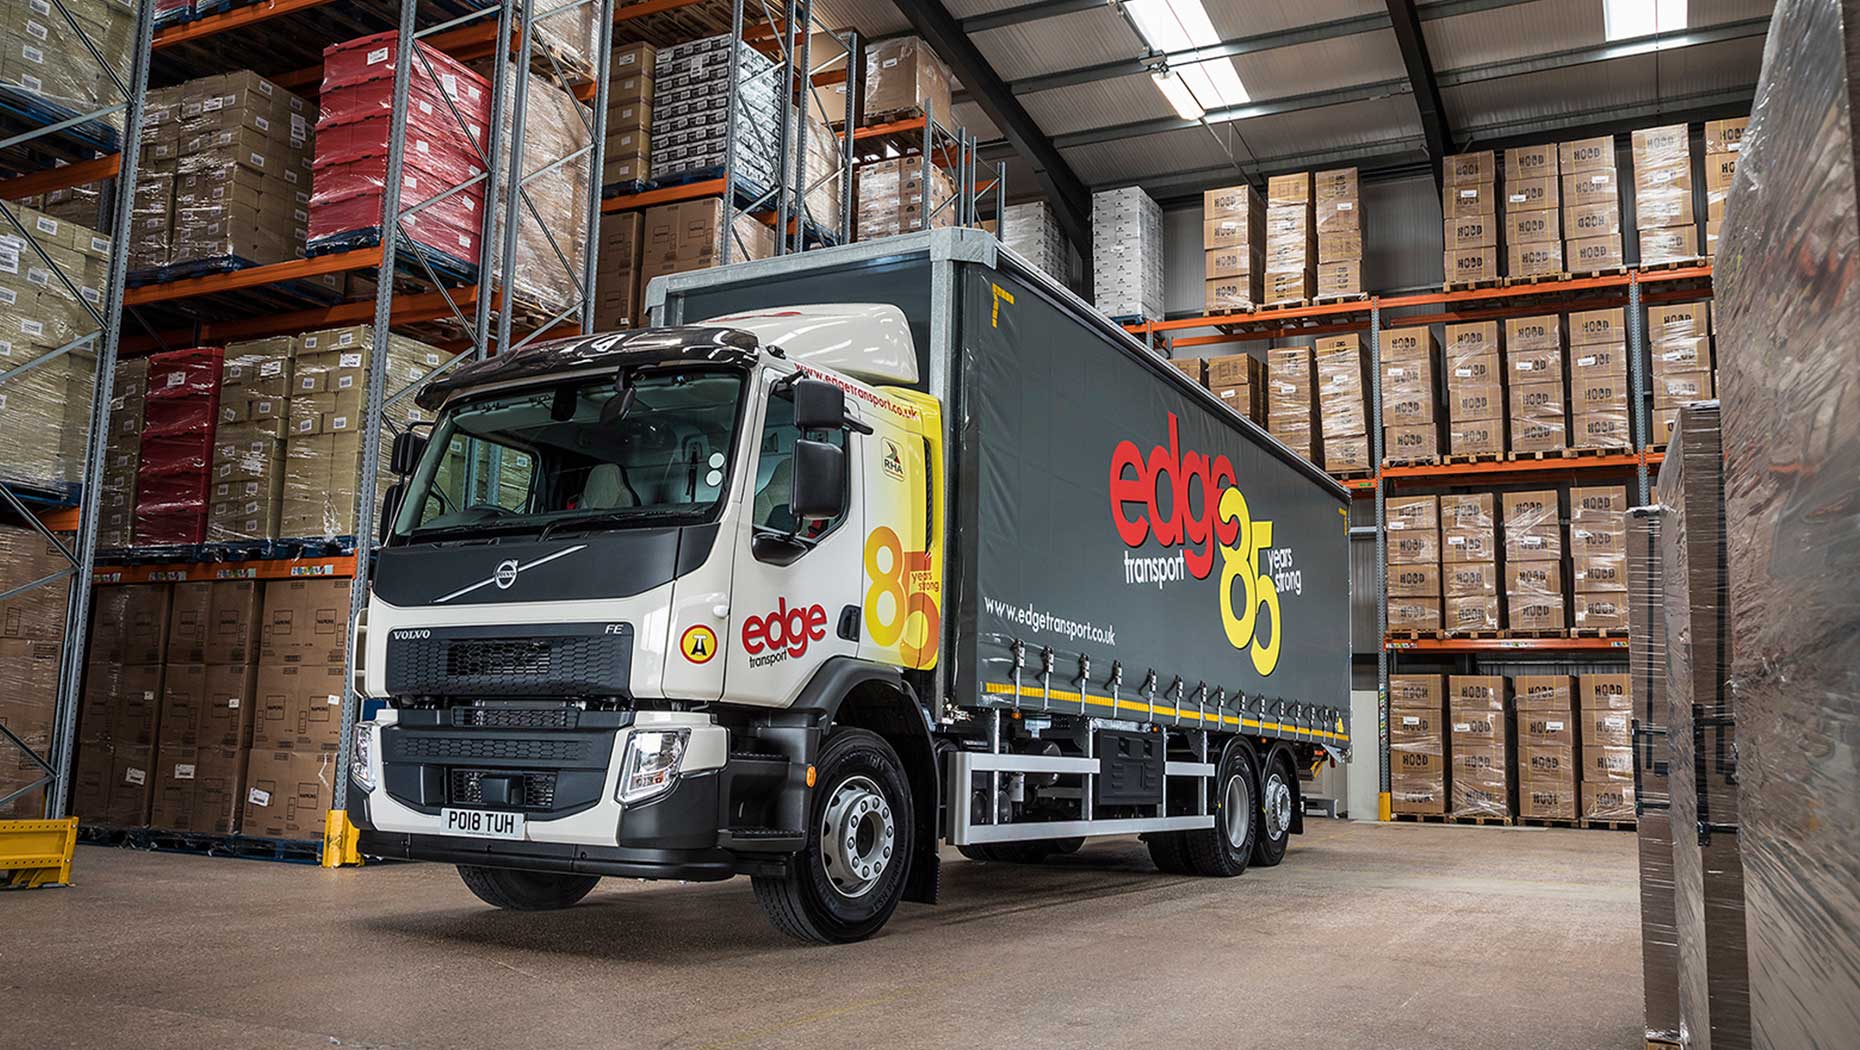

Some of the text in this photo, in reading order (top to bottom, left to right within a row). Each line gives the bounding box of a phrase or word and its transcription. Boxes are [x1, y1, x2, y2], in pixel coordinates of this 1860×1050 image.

[1519, 154, 1544, 167] HOOD
[1574, 147, 1600, 161] HOOD
[1518, 219, 1544, 233] HOOD
[1578, 215, 1605, 229] HOOD
[1457, 224, 1483, 237] HOOD
[1522, 251, 1549, 264] HOOD
[1579, 246, 1606, 258] HOOD
[1457, 257, 1483, 269] HOOD
[1518, 326, 1544, 339] HOOD
[1582, 320, 1609, 332] HOOD
[1391, 337, 1416, 349] HOOD
[1457, 332, 1483, 345] HOOD
[1462, 397, 1487, 409] HOOD
[1523, 393, 1549, 405] HOOD
[1394, 401, 1419, 414] HOOD
[1397, 434, 1422, 446] HOOD
[1462, 430, 1488, 442] HOOD
[884, 459, 904, 475] RHA
[1110, 410, 1239, 580] edge
[1583, 497, 1610, 509] HOOD
[1267, 547, 1293, 576] years
[1124, 549, 1185, 590] transport
[1587, 568, 1615, 580] HOOD
[911, 571, 933, 585] years
[1218, 487, 1281, 676] 85
[1275, 569, 1302, 596] strong
[1400, 573, 1425, 584] HOOD
[1456, 572, 1482, 584] HOOD
[864, 526, 940, 667] 85
[742, 596, 828, 659] edge
[983, 596, 1116, 646] www.edgetransport.co.uk
[393, 629, 431, 640] VOLVO
[604, 624, 625, 635] FE
[749, 649, 787, 669] transport
[1462, 686, 1488, 698] HOOD
[1594, 685, 1623, 696] HOOD
[1402, 754, 1428, 766] HOOD
[1464, 756, 1490, 768] HOOD
[1531, 756, 1559, 769] HOOD
[448, 811, 515, 834] PO18 TUH
